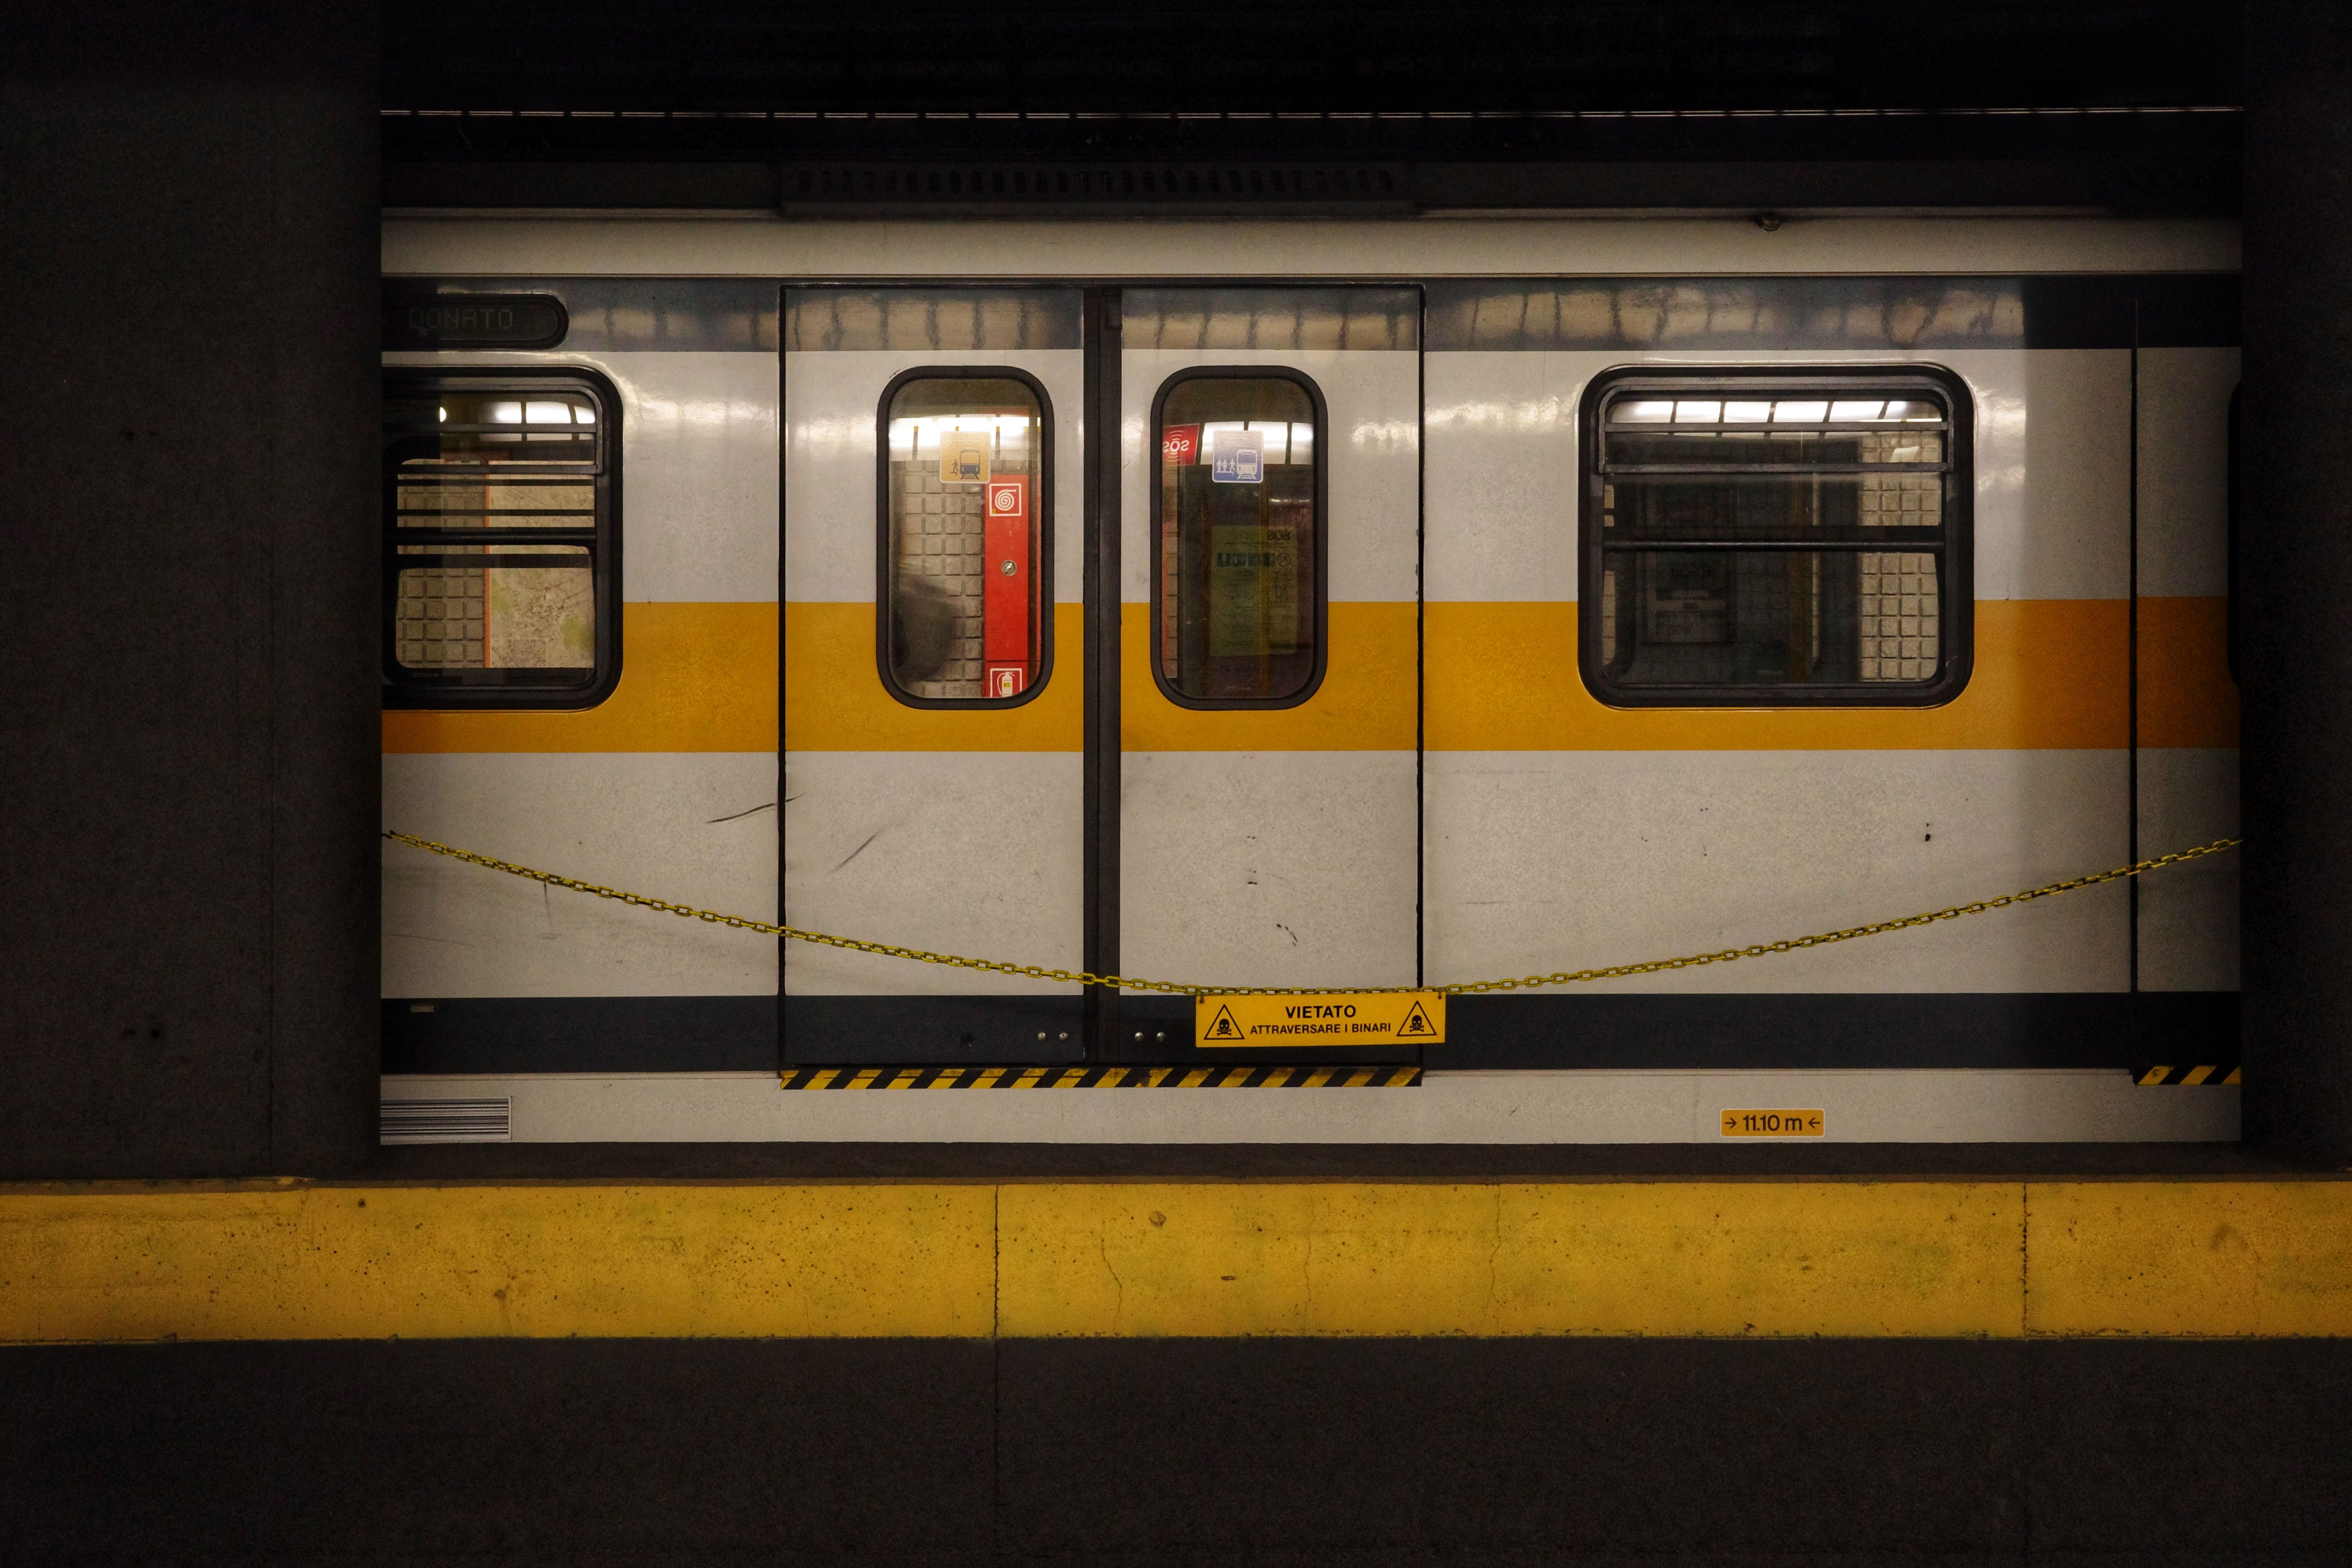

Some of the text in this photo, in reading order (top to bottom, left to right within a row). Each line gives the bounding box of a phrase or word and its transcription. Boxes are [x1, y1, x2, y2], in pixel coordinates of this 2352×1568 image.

[1286, 1005, 1356, 1018] VIETATO
[1250, 1023, 1391, 1034] ATTRAVERSARE I BINARI
[1743, 1115, 1802, 1131] 11.10 m
